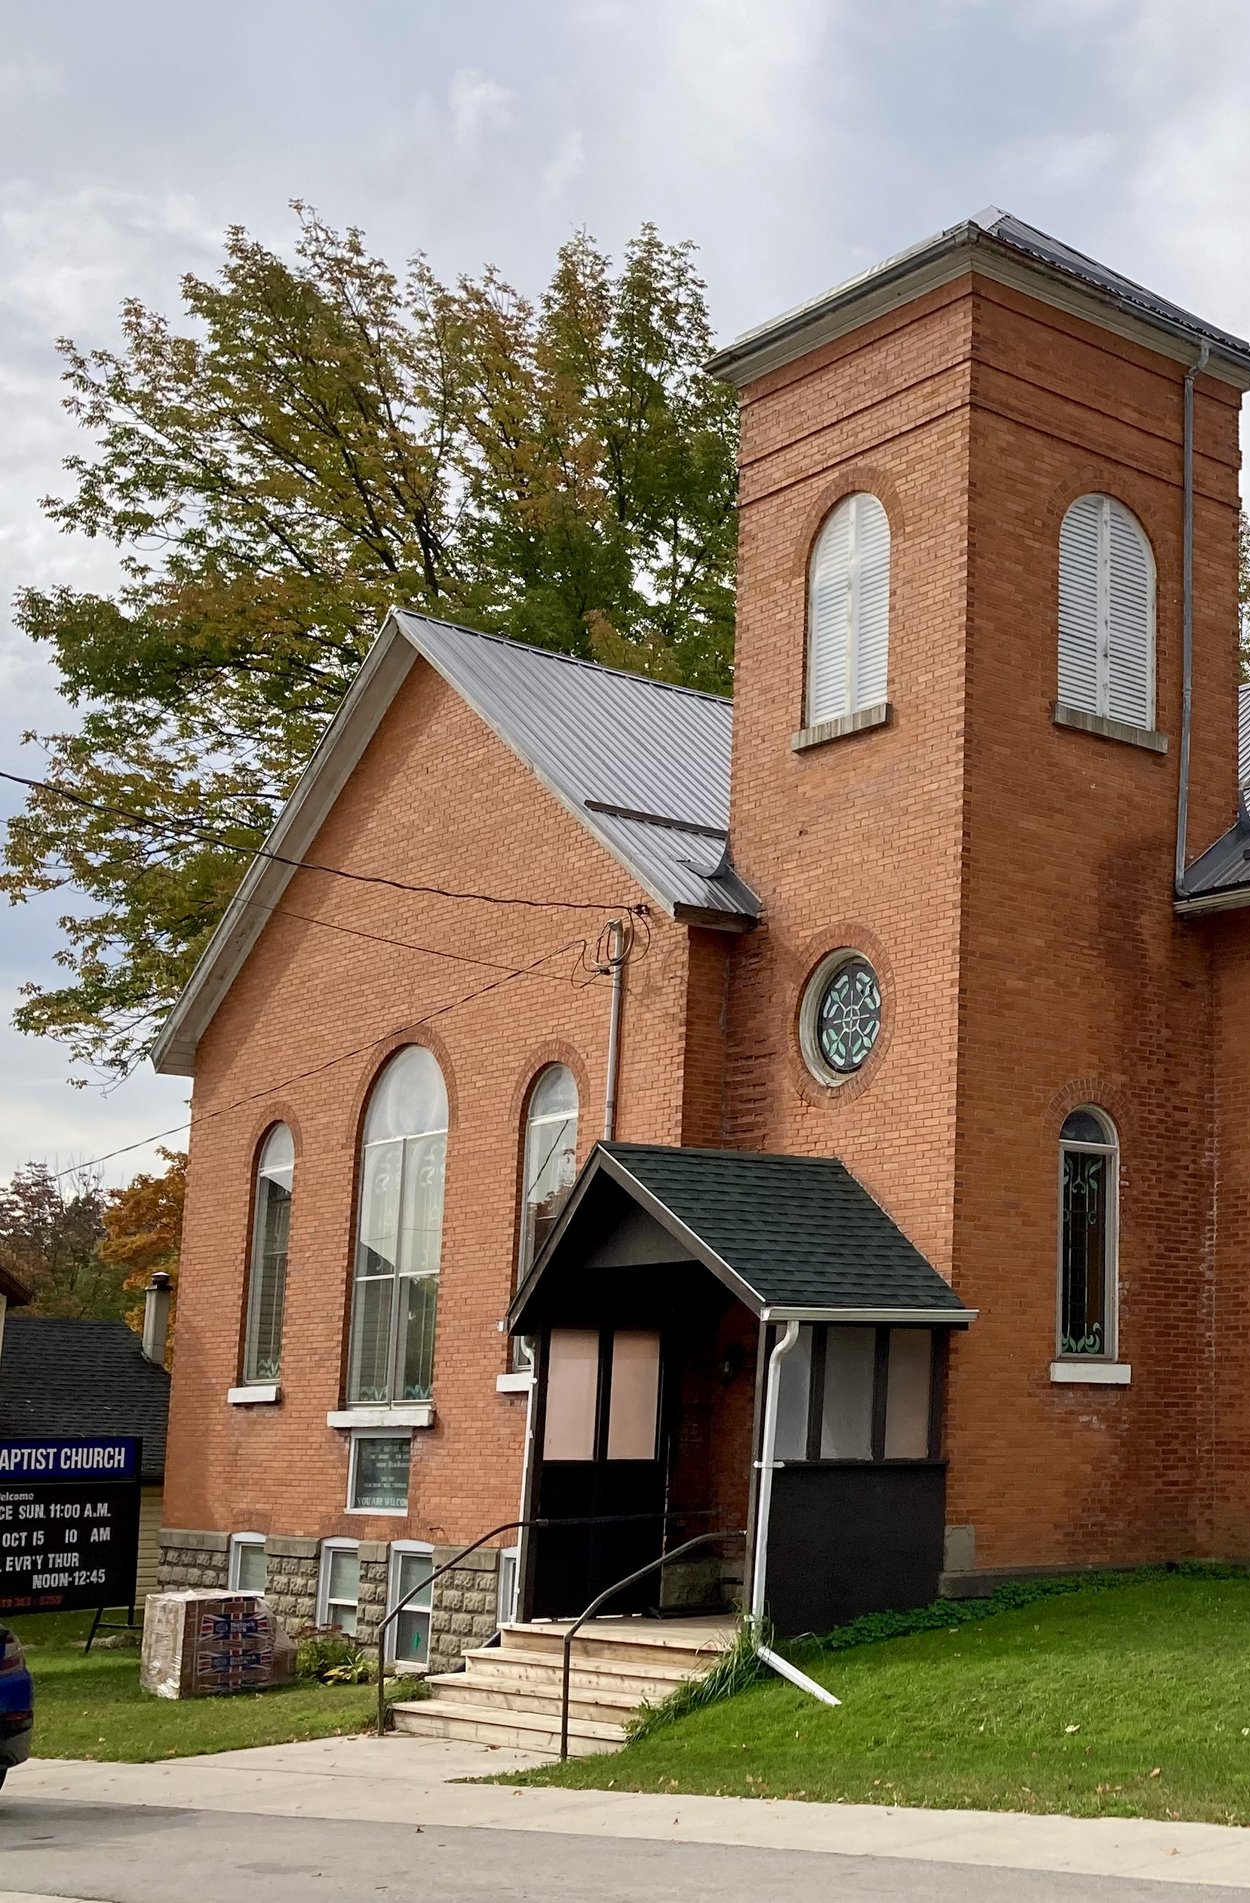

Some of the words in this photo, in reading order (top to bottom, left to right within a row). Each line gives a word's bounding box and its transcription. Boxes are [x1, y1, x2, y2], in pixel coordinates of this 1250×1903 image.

[60, 1447, 125, 1469] CHURCH
[0, 1491, 34, 1501] elcome
[49, 1503, 81, 1518] 11:00
[83, 1503, 111, 1518] A.M.
[2, 1532, 27, 1547] OCT
[32, 1530, 45, 1546] 15
[90, 1527, 111, 1542] AM
[5, 1555, 44, 1571] EVR'Y
[47, 1552, 80, 1568] THUR
[32, 1569, 106, 1589] NOON-12:45
